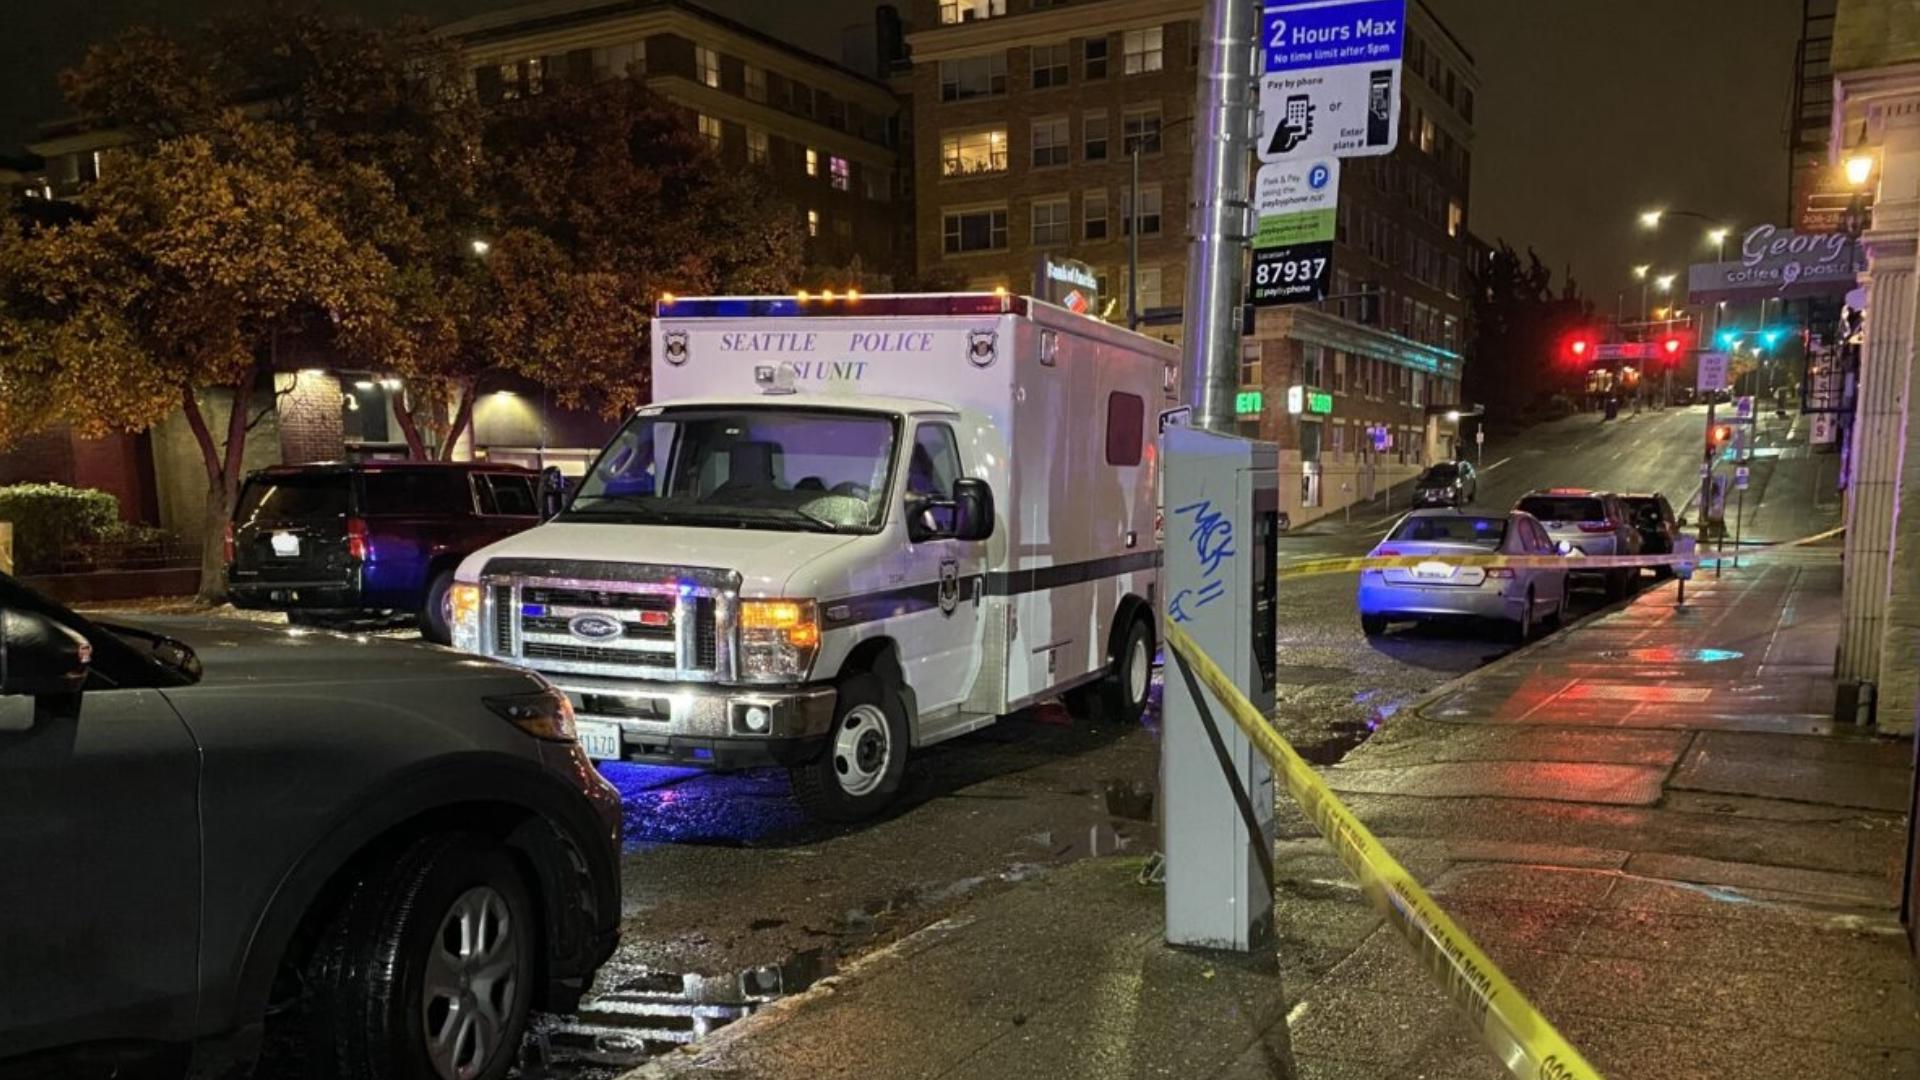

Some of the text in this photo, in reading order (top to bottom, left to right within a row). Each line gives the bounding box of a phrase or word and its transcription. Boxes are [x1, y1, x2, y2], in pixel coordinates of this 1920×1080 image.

[1270, 18, 1396, 48] 2 Hours Max
[1274, 43, 1390, 64] No time limit after 5pm
[1267, 78, 1323, 90] Pay by phone
[1329, 102, 1342, 112] or
[1340, 128, 1364, 137] Enter
[1333, 141, 1355, 151] plate
[1256, 258, 1326, 284] 87937
[1728, 268, 1779, 281] coffee
[720, 332, 934, 351] SEATTLE POLICE
[816, 361, 868, 380] UNIT
